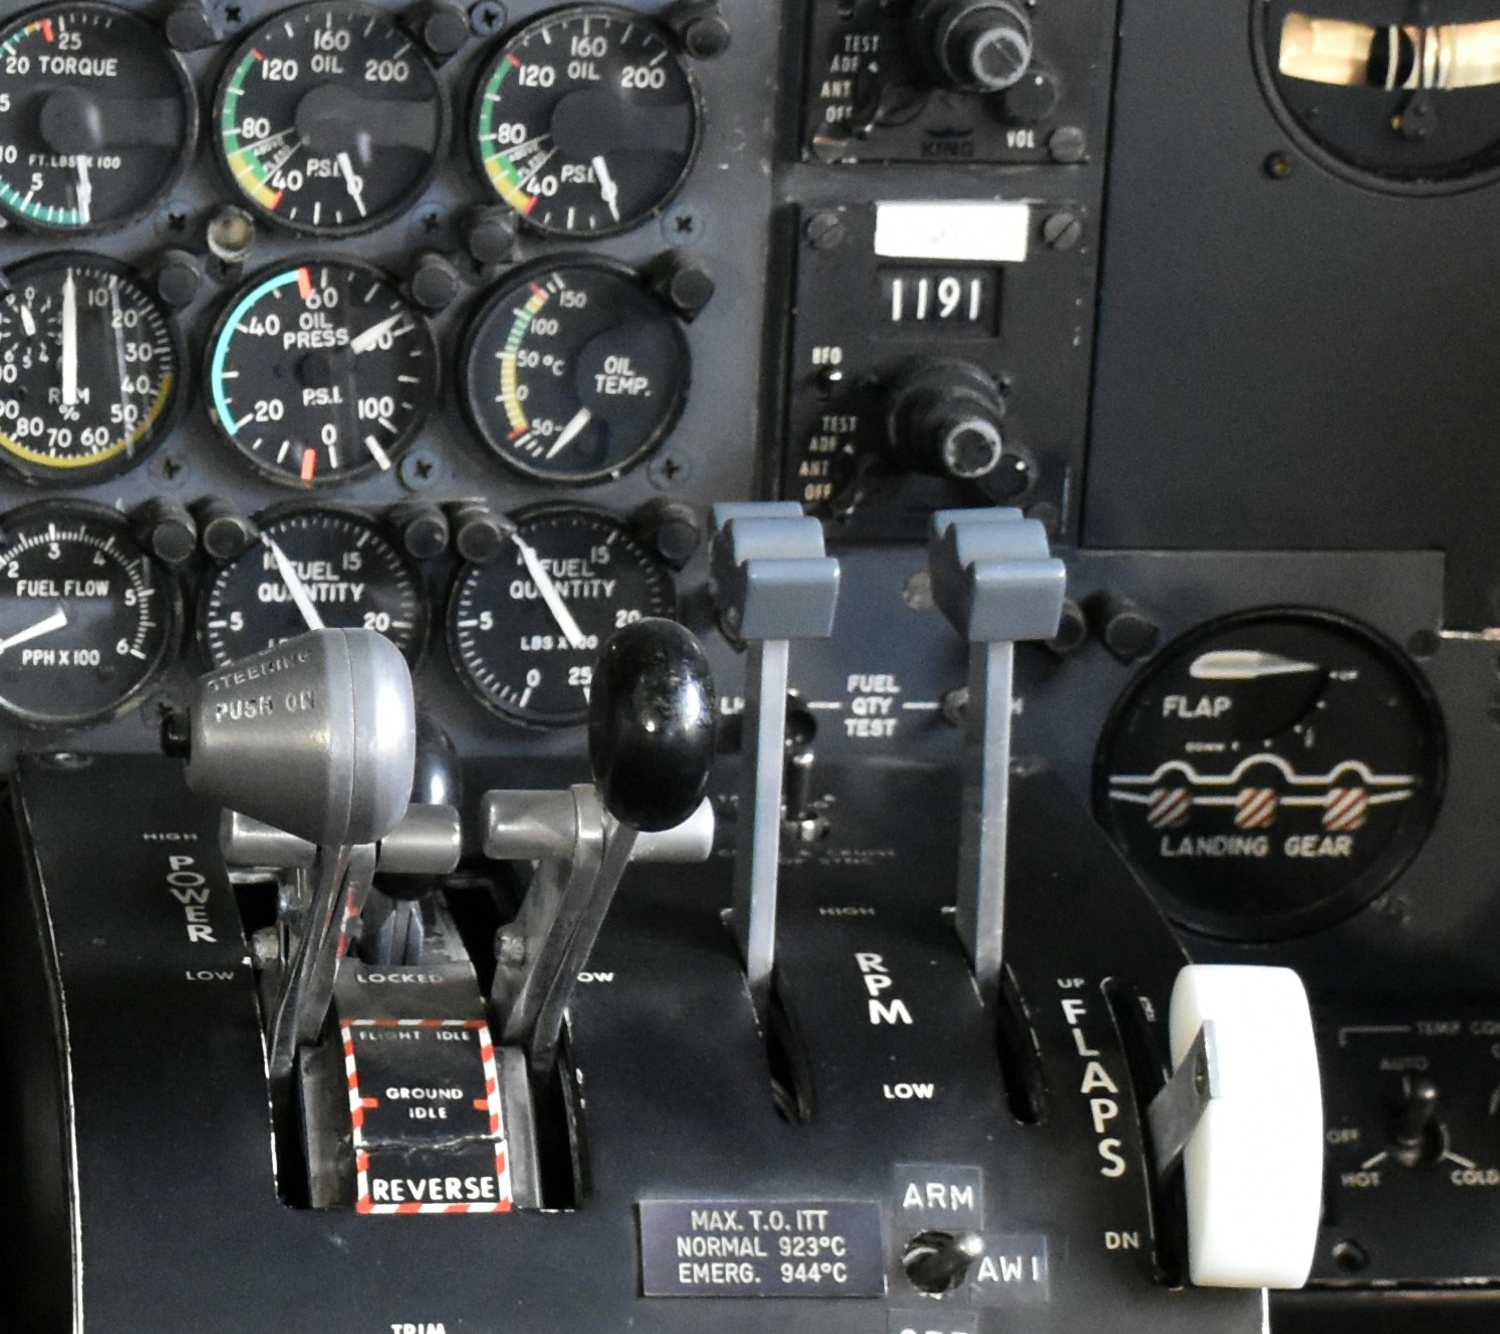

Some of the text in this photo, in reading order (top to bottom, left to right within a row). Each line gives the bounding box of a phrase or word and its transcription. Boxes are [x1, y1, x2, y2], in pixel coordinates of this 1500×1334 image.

[889, 276, 981, 322] 1191
[846, 673, 901, 694] FUEL
[851, 696, 893, 716] QTY
[1162, 695, 1232, 719] FLAP
[843, 717, 897, 738] TEST
[1160, 834, 1353, 858] LANDING GEAR
[169, 855, 213, 944] POWER
[855, 952, 913, 1026] RPM
[385, 1087, 464, 1100] GROUND
[1062, 999, 1126, 1178] FLAPS
[409, 1106, 447, 1119] IDLE
[373, 1176, 494, 1201] REVERSE
[902, 1182, 974, 1211] ARM
[690, 1209, 829, 1231] MAX. T.O. ITT
[676, 1235, 847, 1258] NORMAL 923°C
[678, 1261, 848, 1284] EMERG. 944°C
